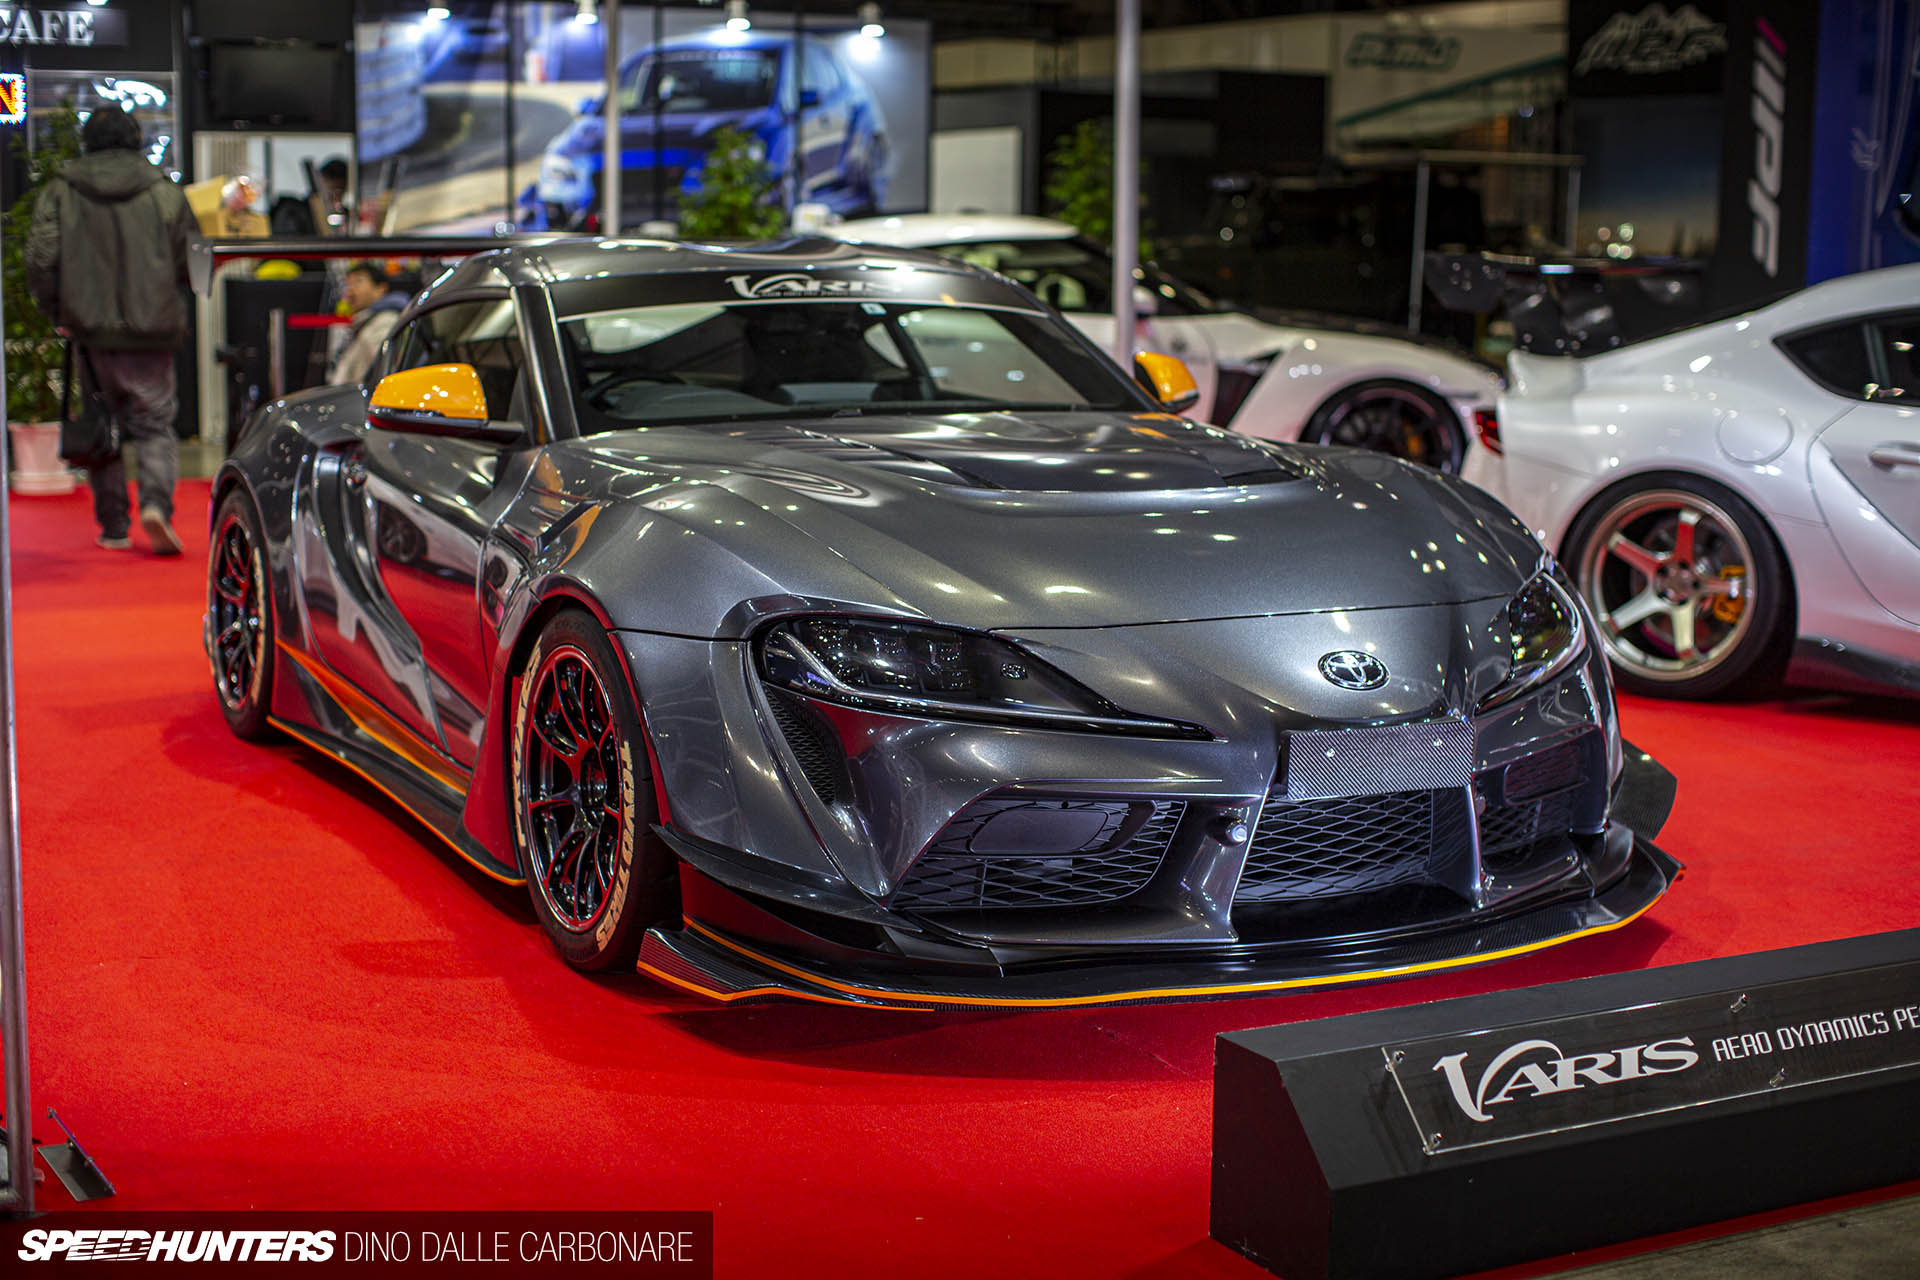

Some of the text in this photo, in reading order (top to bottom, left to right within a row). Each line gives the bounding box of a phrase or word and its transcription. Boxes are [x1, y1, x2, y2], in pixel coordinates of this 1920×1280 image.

[595, 740, 635, 953] TOYO TIRES
[1432, 1004, 1920, 1122] VARIS AERO DYNAMICS PE
